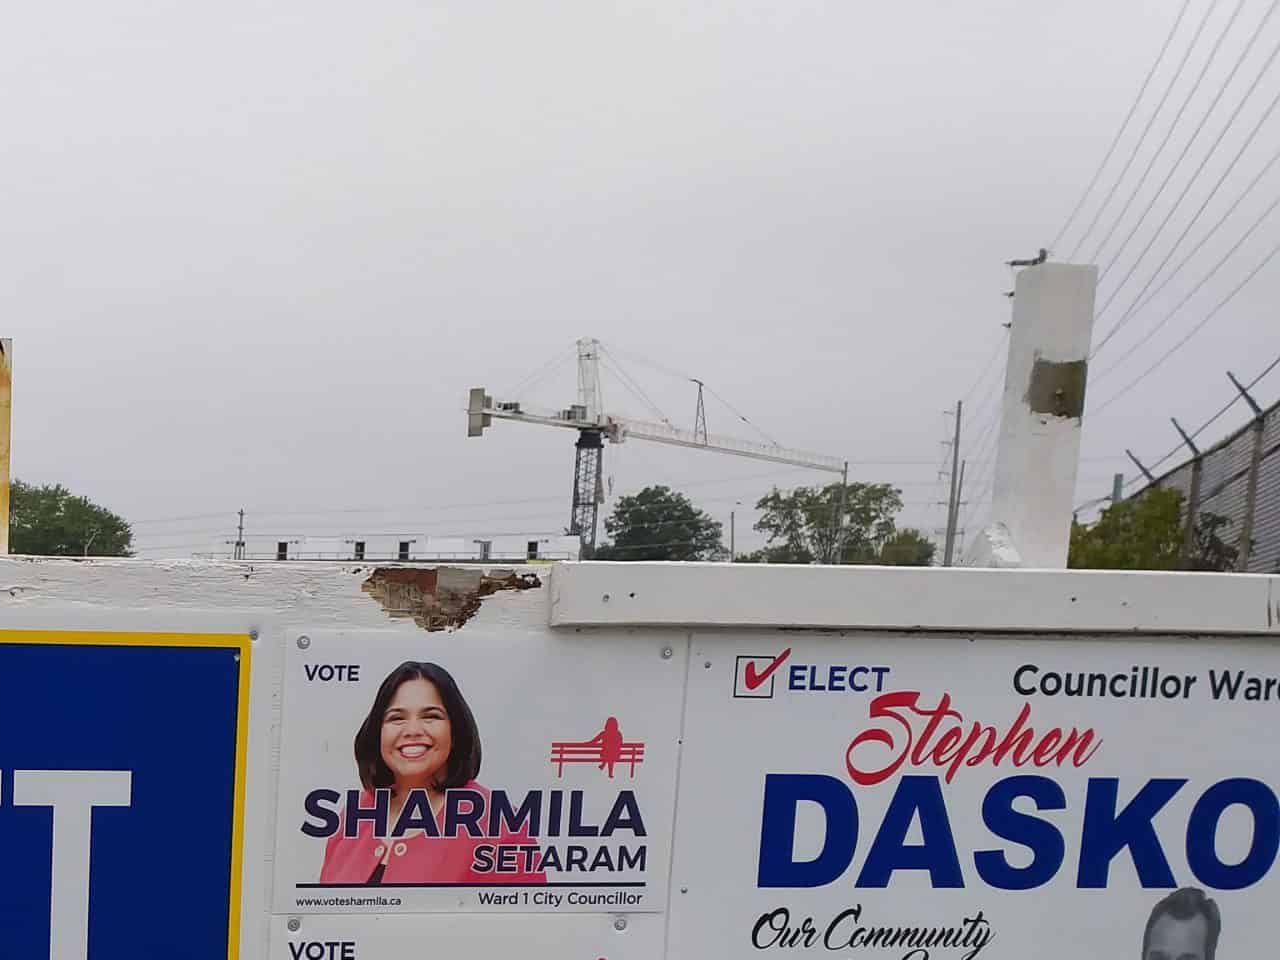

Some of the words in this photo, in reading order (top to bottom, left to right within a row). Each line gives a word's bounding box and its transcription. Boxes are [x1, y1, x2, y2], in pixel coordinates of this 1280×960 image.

[304, 664, 360, 682] VOTE
[788, 665, 890, 692] ELECT
[1013, 664, 1197, 699] Councillor
[846, 691, 1104, 786] Stephen
[299, 788, 647, 839] SHARMILA
[756, 774, 1280, 891] DASKO
[471, 844, 647, 874] SETARAM
[296, 896, 402, 908] www.votesharmila.ca
[478, 892, 519, 906] Ward
[523, 892, 529, 905] 1
[533, 891, 563, 908] City
[567, 891, 642, 906] Councillor
[751, 907, 820, 950] Our
